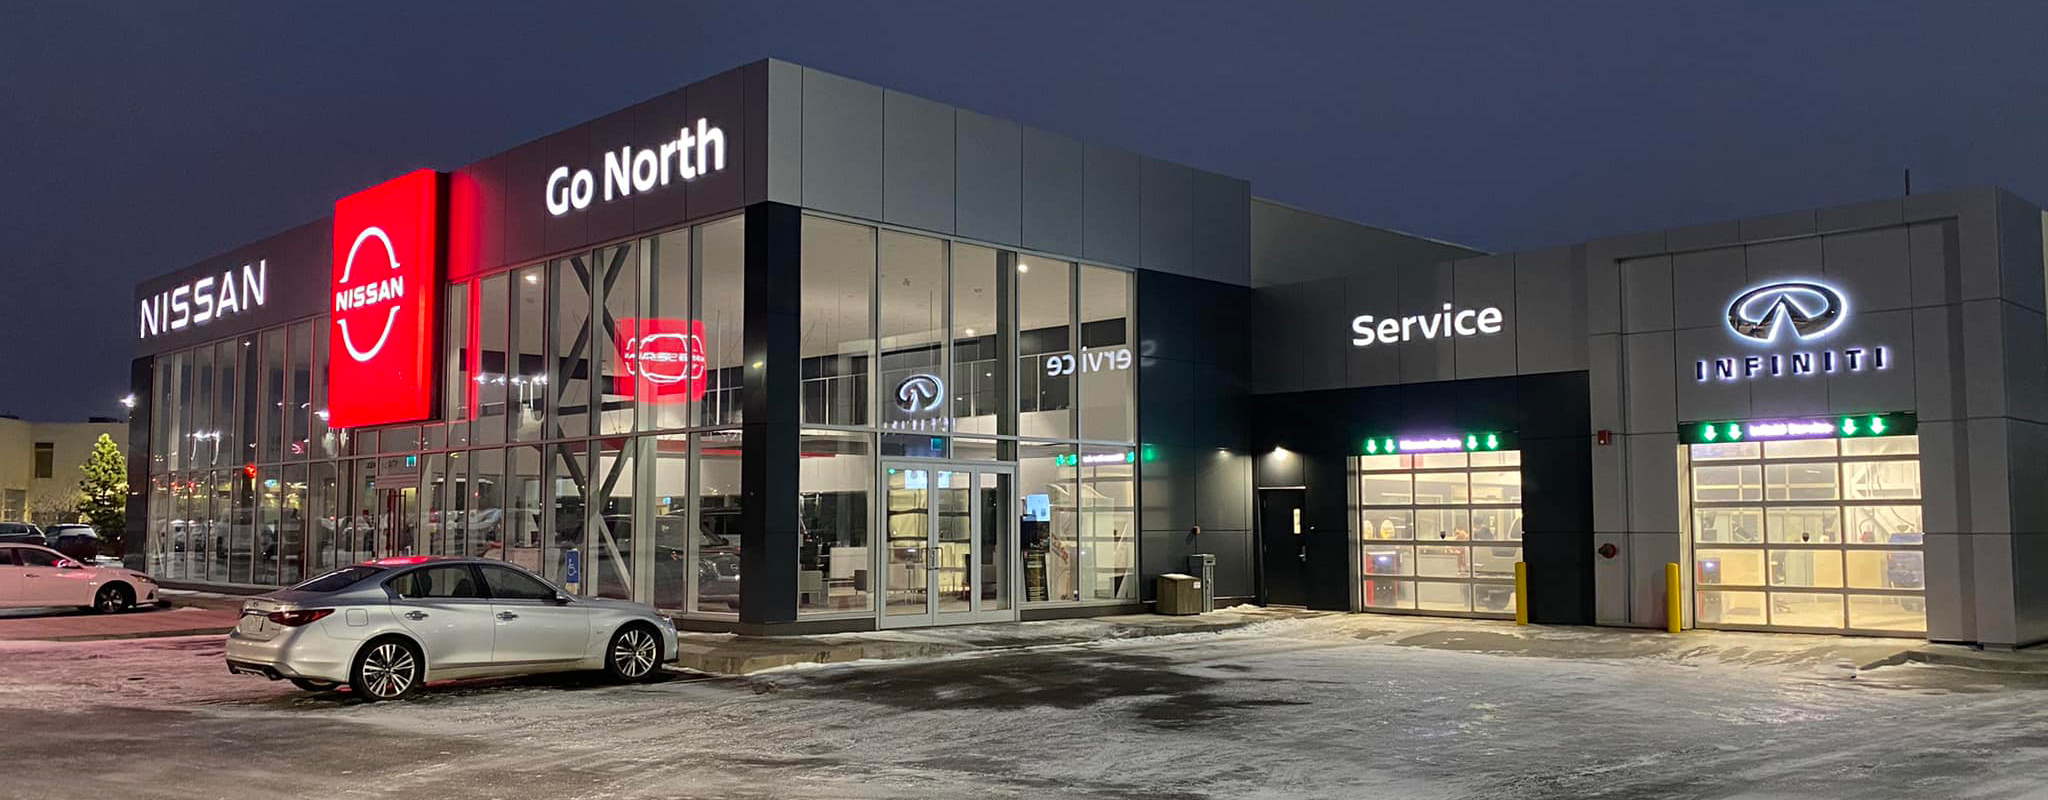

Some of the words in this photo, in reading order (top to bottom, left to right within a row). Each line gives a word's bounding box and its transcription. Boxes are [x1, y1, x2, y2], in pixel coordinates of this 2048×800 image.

[546, 166, 595, 215] Go
[604, 117, 725, 201] North
[140, 259, 266, 339] NISSAN
[335, 275, 404, 312] NISSAN
[1351, 303, 1504, 347] Service
[1696, 347, 1888, 382] INFINITI
